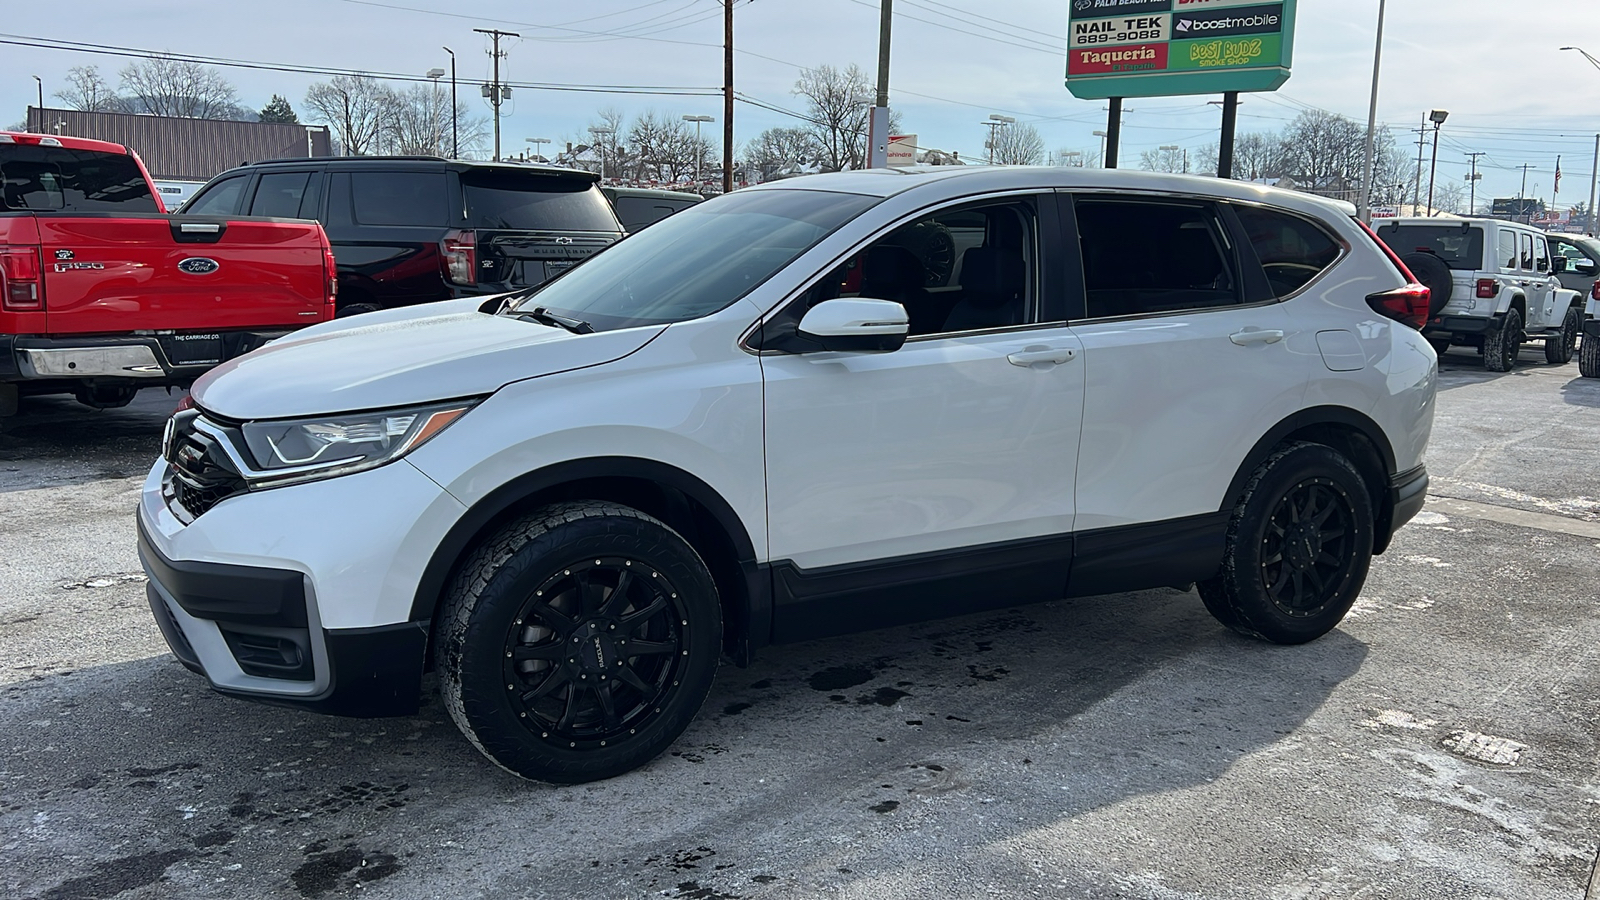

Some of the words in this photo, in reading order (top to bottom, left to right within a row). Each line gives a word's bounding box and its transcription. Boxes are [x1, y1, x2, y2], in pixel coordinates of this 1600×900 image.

[1076, 21, 1116, 34] NAIL
[1124, 17, 1162, 30] TEK
[1077, 29, 1160, 44] 689-9088
[1224, 38, 1262, 57] BUDZ
[1199, 58, 1226, 67] SMOKE
[1227, 57, 1250, 66] SHOP
[188, 261, 211, 271] Ford
